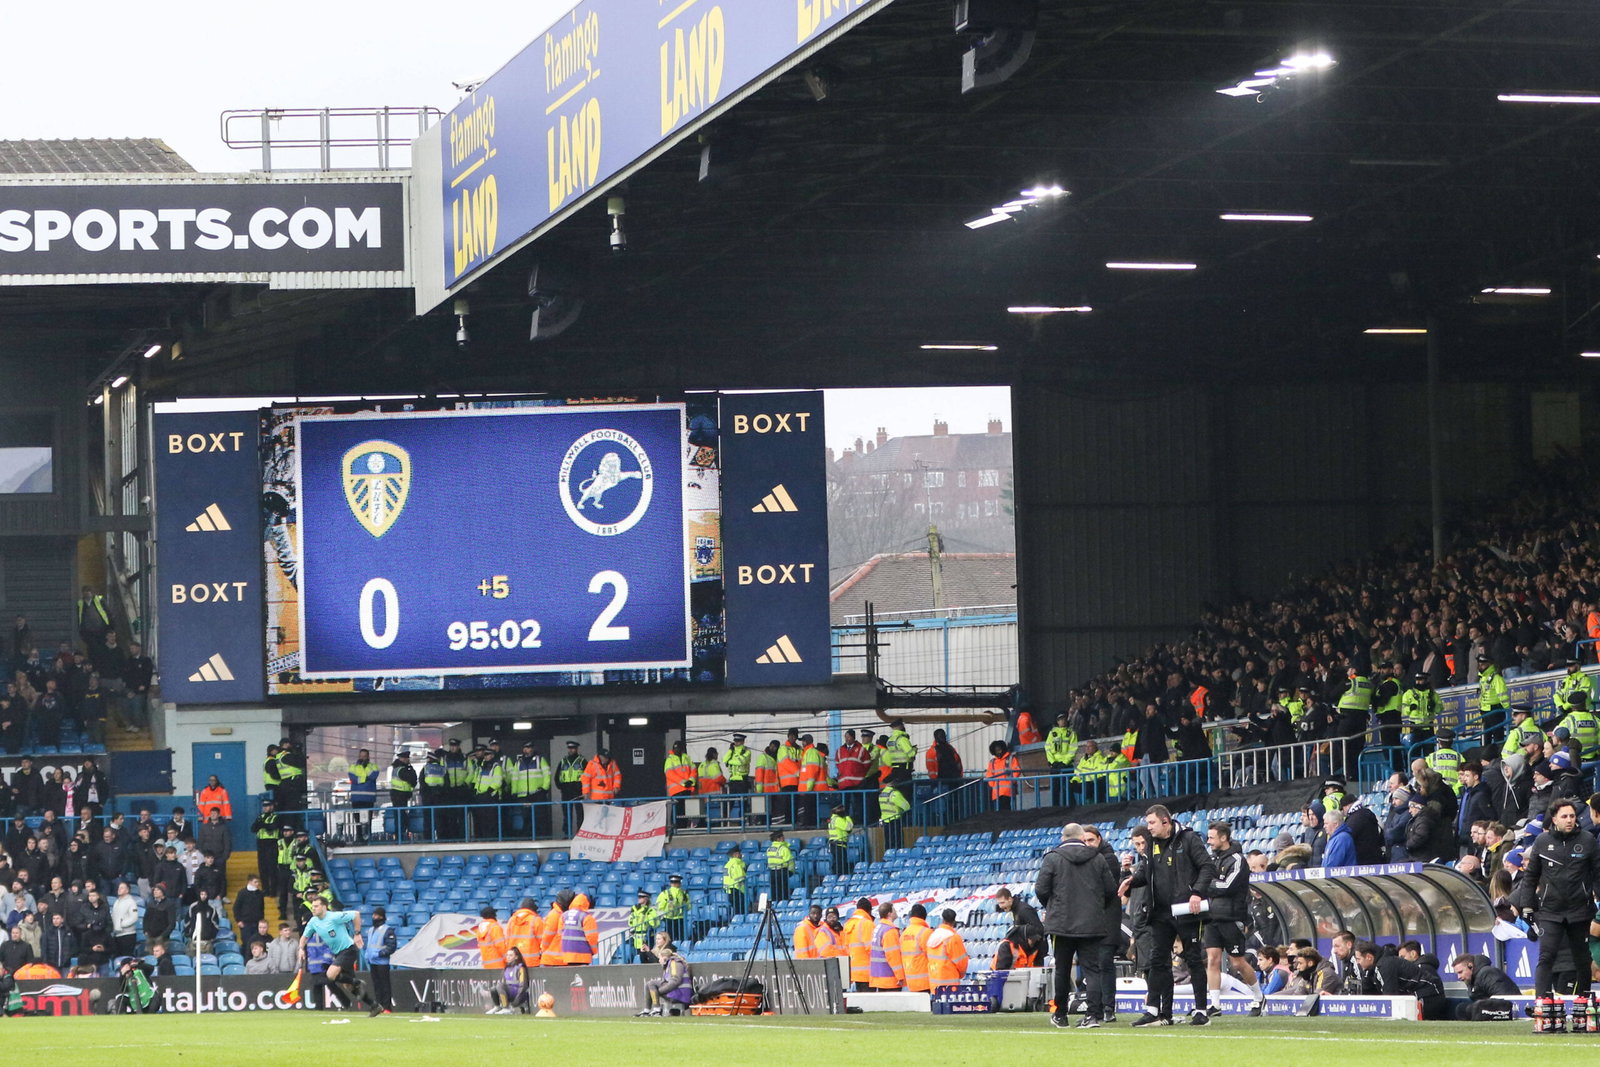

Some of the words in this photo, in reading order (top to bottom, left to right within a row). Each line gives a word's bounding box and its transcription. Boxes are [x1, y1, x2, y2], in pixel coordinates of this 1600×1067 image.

[544, 9, 599, 94] flamingo
[660, 5, 725, 136] LAND
[450, 93, 495, 168] flamingo
[547, 97, 601, 213] LAND
[0, 207, 382, 252] SPORTS.COM
[453, 174, 498, 278] LAND
[168, 432, 244, 453] BOXT
[733, 413, 811, 434] BOXT
[560, 438, 589, 482] MILLWALL
[591, 430, 638, 452] FOOTBALL
[171, 582, 248, 604] BOXT
[476, 574, 510, 600] +5
[737, 564, 815, 585] BOXT
[359, 577, 400, 650] 0
[587, 570, 630, 642] 2
[446, 619, 542, 651] 95:02
